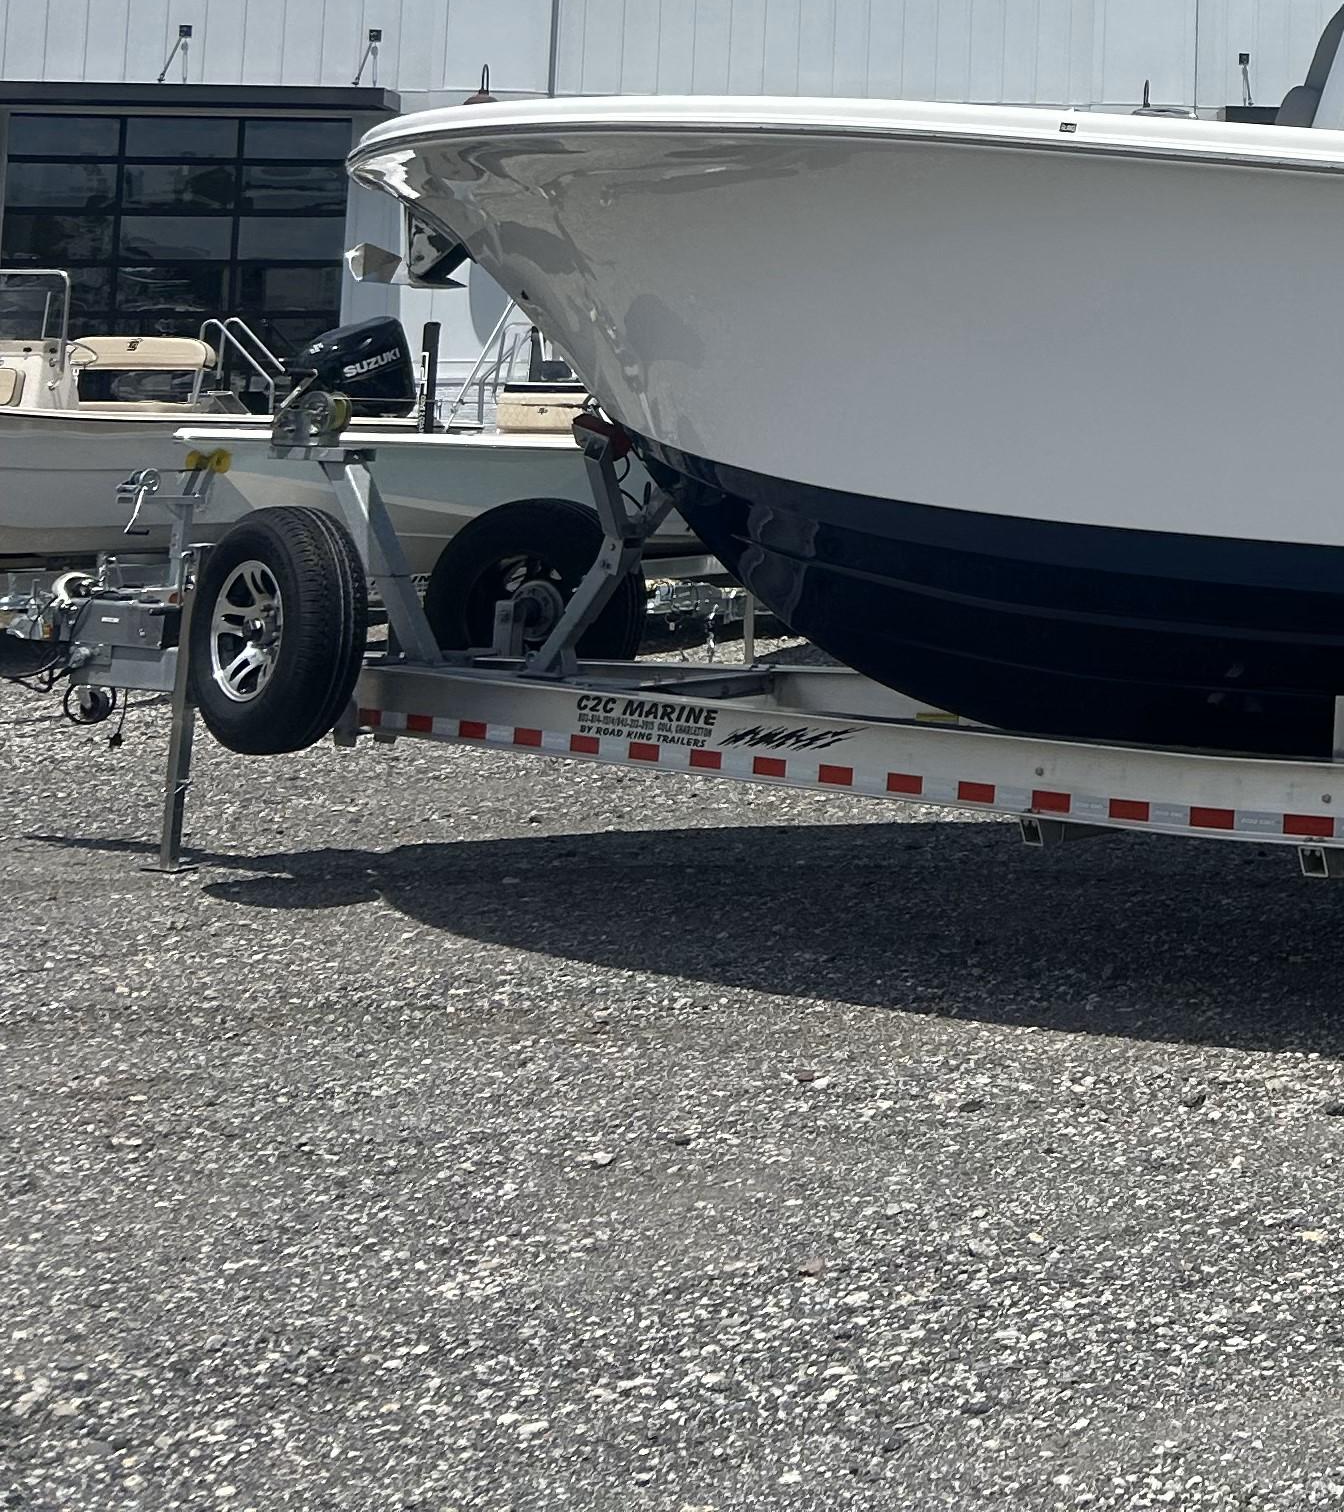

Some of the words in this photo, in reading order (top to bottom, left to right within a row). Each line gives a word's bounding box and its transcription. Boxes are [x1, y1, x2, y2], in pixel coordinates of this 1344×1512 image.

[342, 347, 401, 378] SUZUKI
[576, 694, 617, 714] C2C
[622, 699, 720, 727] MARINE
[579, 724, 594, 734] BY
[595, 726, 624, 738] ROAD
[626, 730, 653, 742] KING
[656, 734, 707, 748] TRAILERS
[675, 724, 713, 738] CHARLESTON
